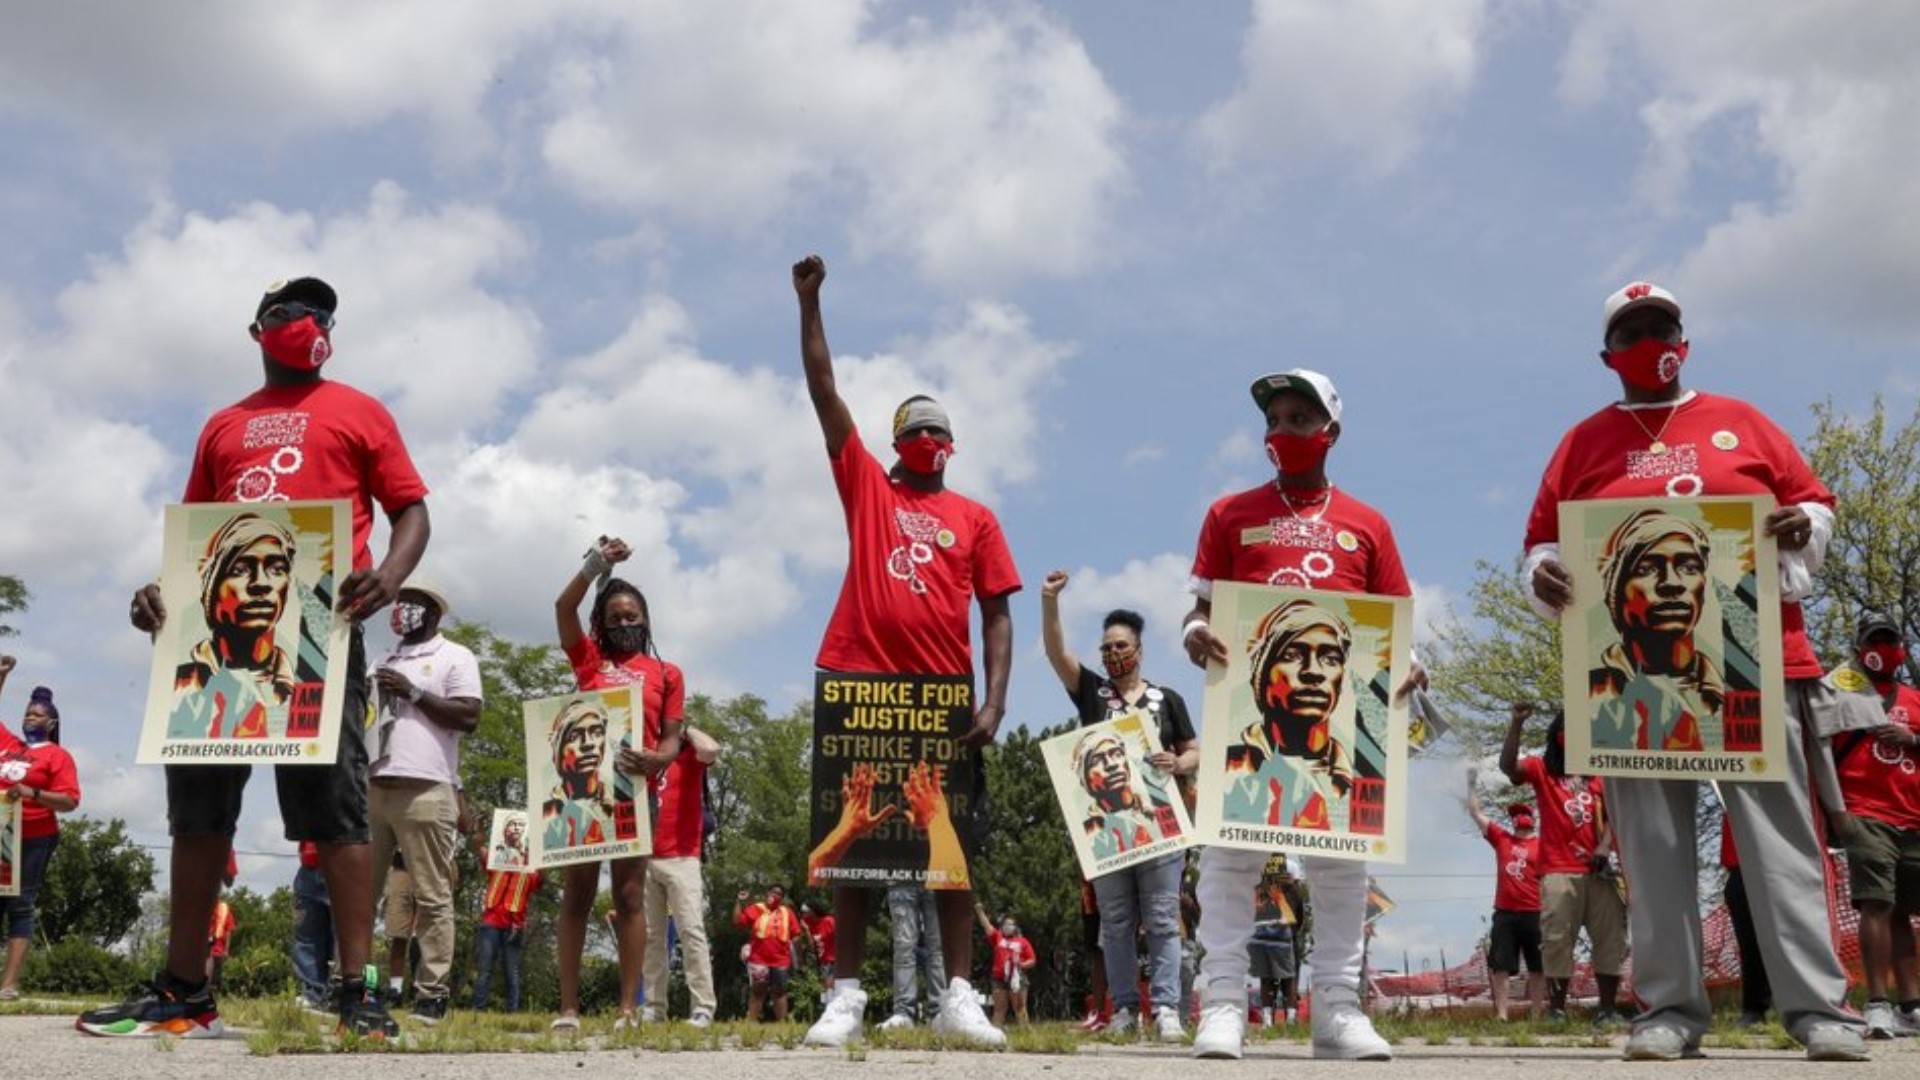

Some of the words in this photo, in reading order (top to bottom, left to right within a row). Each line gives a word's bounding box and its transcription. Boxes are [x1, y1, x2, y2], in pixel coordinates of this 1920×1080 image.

[823, 680, 914, 705] STRIKE
[922, 683, 970, 706] FOR
[844, 706, 949, 731] JUSTICE
[161, 742, 301, 758] #STRIKEFORBLACKLIVES
[821, 735, 912, 759] STRIKE
[921, 737, 968, 761] FOR
[1589, 755, 1745, 773] #STRIKEFORBLACKLIVES
[1219, 827, 1368, 853] #STRIKEFORBLACKLIVES
[813, 867, 913, 881] #STRIKEFORBLACK
